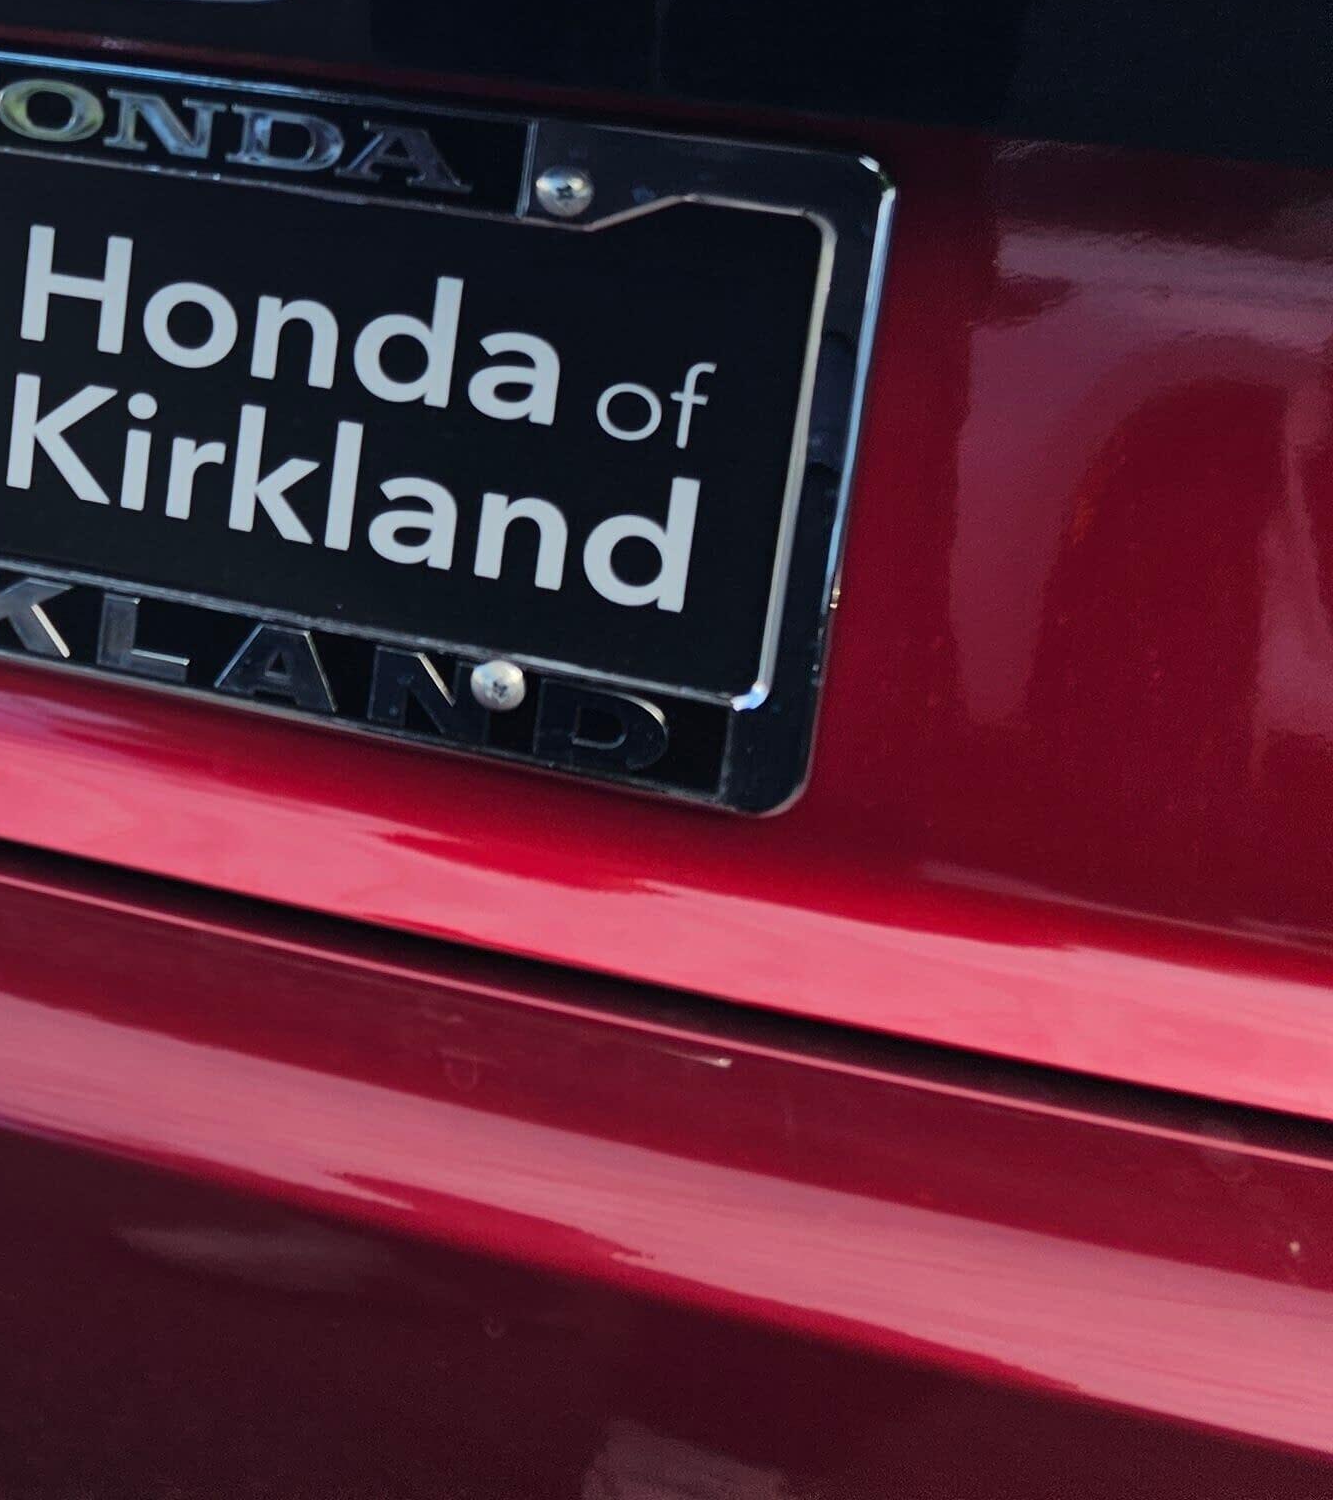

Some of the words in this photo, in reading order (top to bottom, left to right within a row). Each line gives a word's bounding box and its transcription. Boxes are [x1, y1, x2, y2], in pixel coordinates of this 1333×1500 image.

[20, 224, 560, 426] Honda
[596, 363, 717, 449] of
[6, 372, 701, 613] Kirkland
